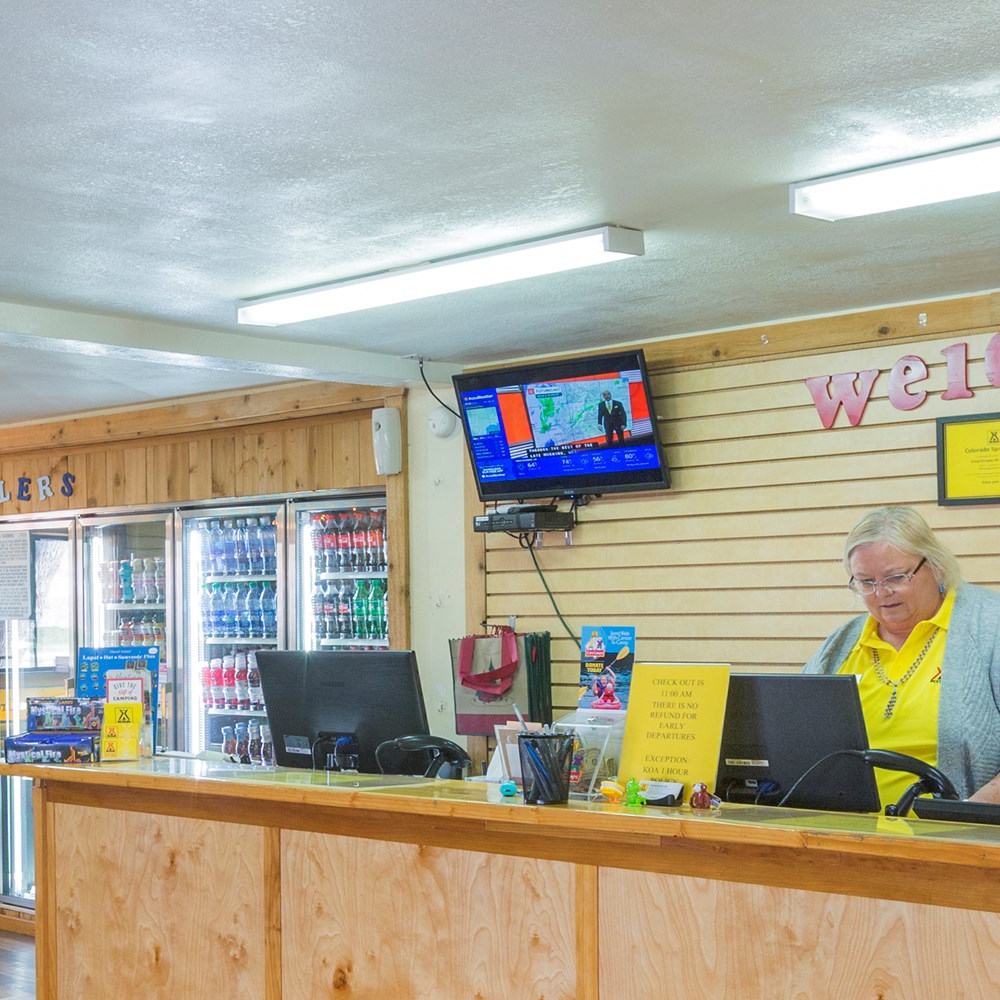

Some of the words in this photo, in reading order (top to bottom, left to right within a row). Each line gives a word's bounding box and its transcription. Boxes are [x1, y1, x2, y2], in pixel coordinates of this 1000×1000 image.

[113, 682, 125, 690] GIVE
[697, 679, 705, 687] IS
[30, 705, 64, 716] Mystical
[65, 705, 81, 715] Fire
[659, 722, 685, 730] EARLY
[646, 732, 696, 741] DEPARTURES
[7, 750, 44, 760] Mystical
[45, 750, 62, 759] Fire
[666, 767, 689, 775] HOUR
